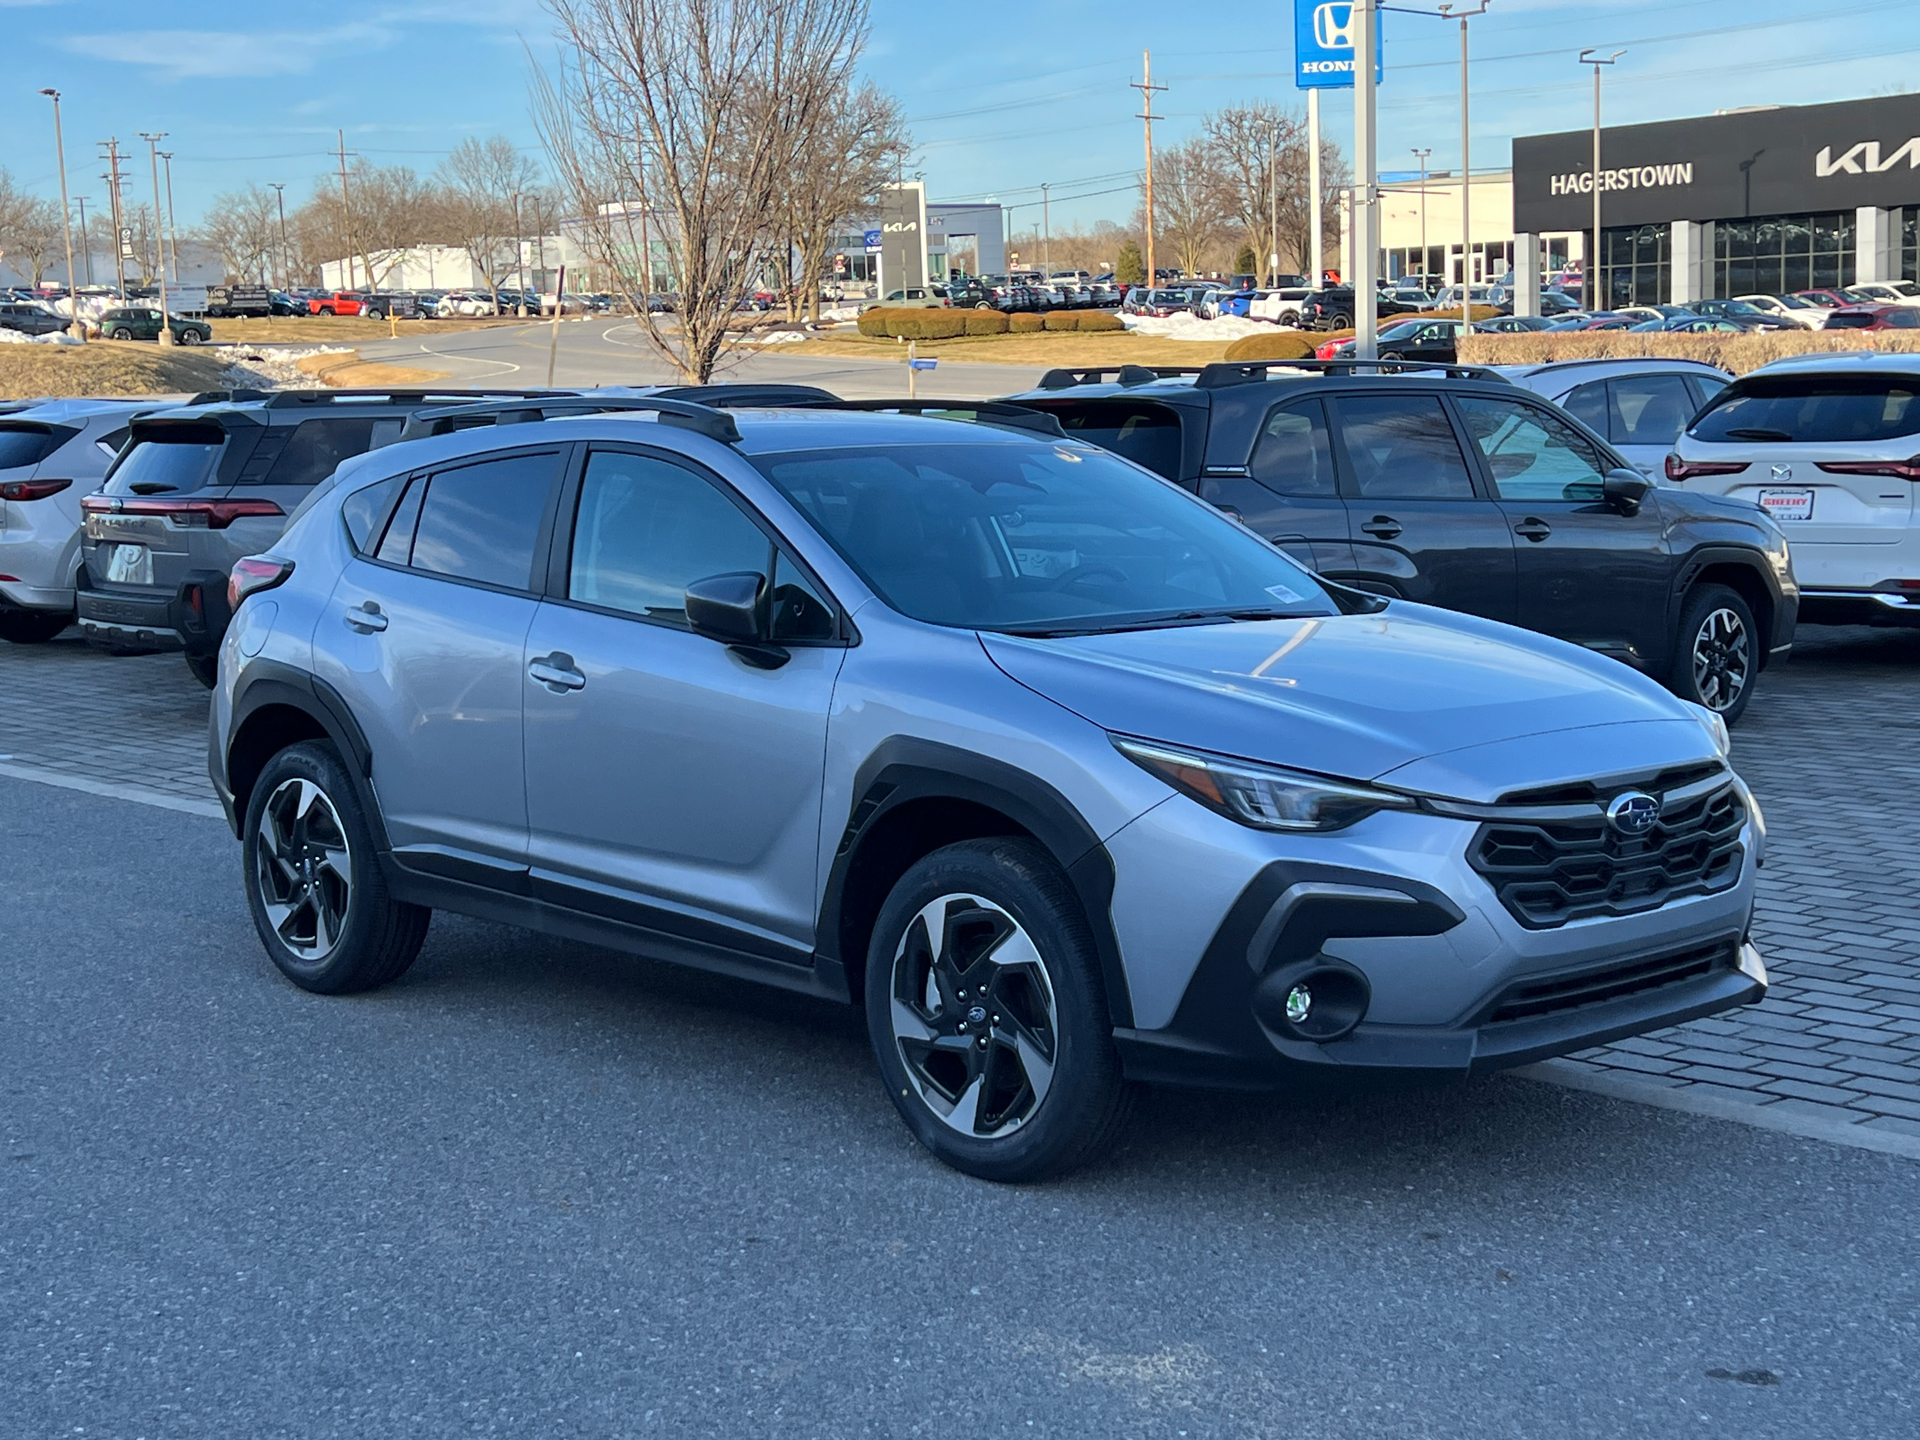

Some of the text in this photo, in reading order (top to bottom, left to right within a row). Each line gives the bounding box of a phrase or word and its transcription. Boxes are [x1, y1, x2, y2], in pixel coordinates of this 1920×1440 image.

[1302, 60, 1380, 74] HON
[1815, 136, 1920, 177] KIA
[1550, 162, 1693, 196] HAGERSTOWN
[883, 221, 917, 233] KIA
[1763, 497, 1808, 506] SHEEHY
